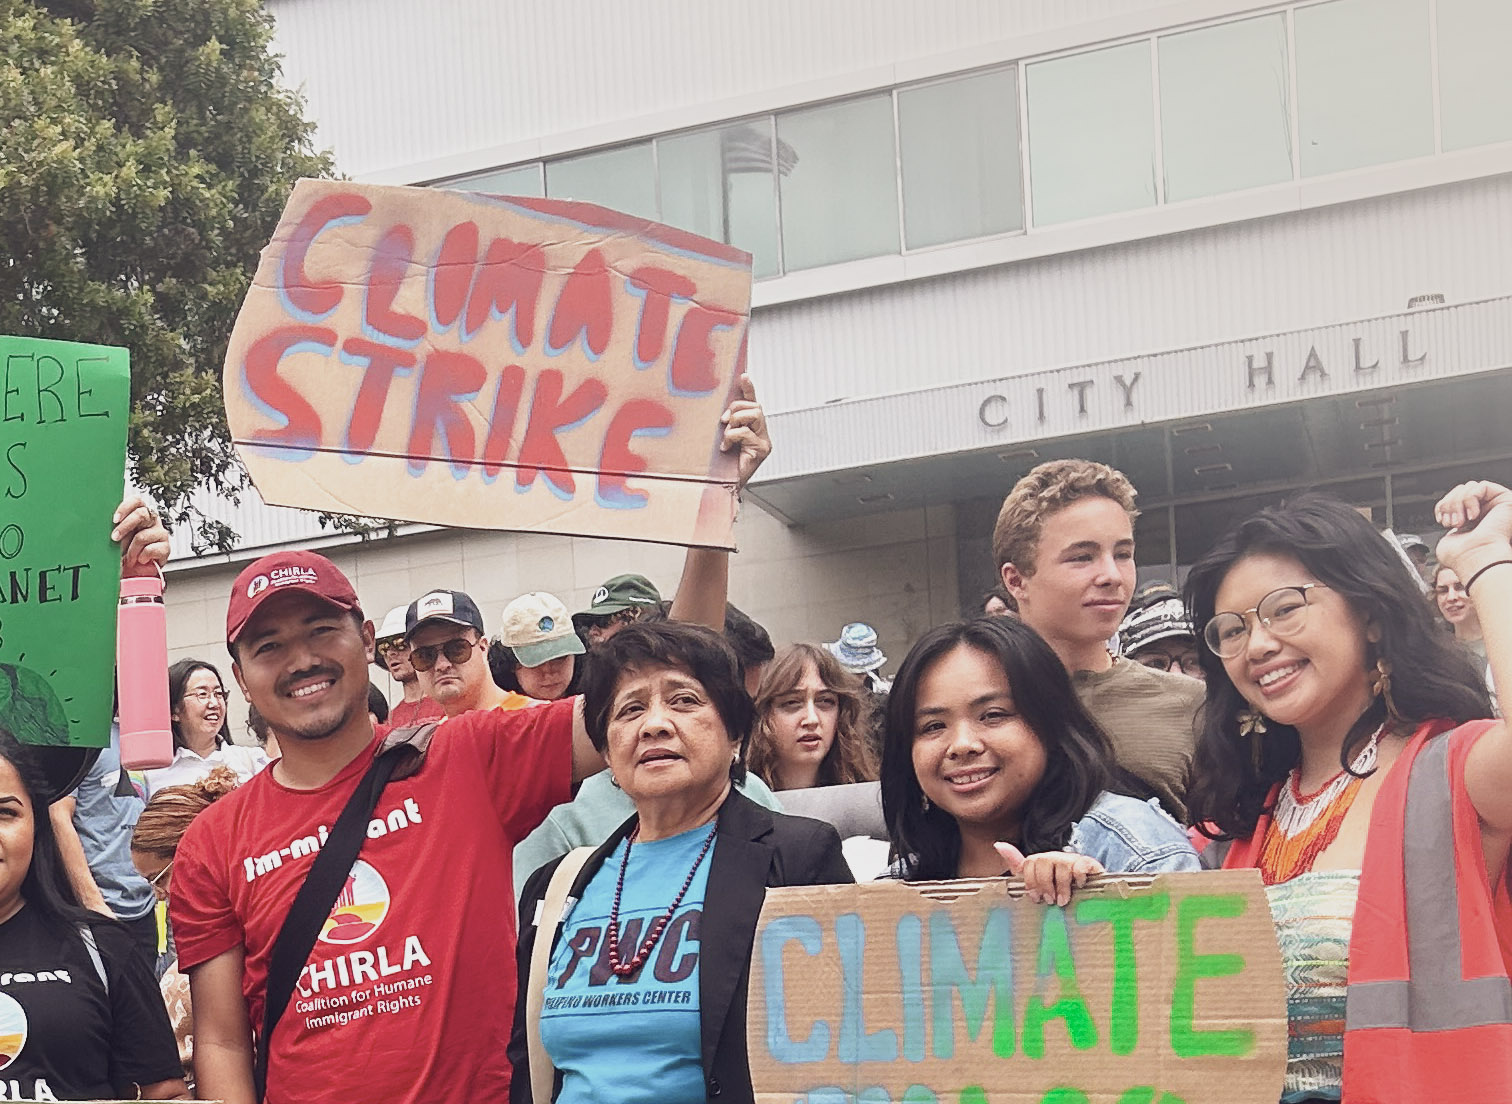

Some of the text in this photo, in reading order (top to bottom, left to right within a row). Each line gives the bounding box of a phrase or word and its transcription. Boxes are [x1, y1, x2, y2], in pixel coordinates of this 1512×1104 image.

[277, 193, 740, 397] CLIMATE
[978, 330, 1428, 430] CITY HALL
[240, 324, 676, 509] STRIKE
[270, 566, 317, 579] CHIRLA
[296, 935, 432, 998] CHIRLA
[555, 909, 703, 989] PWC
[760, 892, 1256, 1064] CLIMATE
[296, 974, 433, 1013] Coalition for Humane
[306, 995, 421, 1030] Immigrant Rights
[582, 991, 641, 1008] WORKERS
[642, 990, 692, 1005] CENTER
